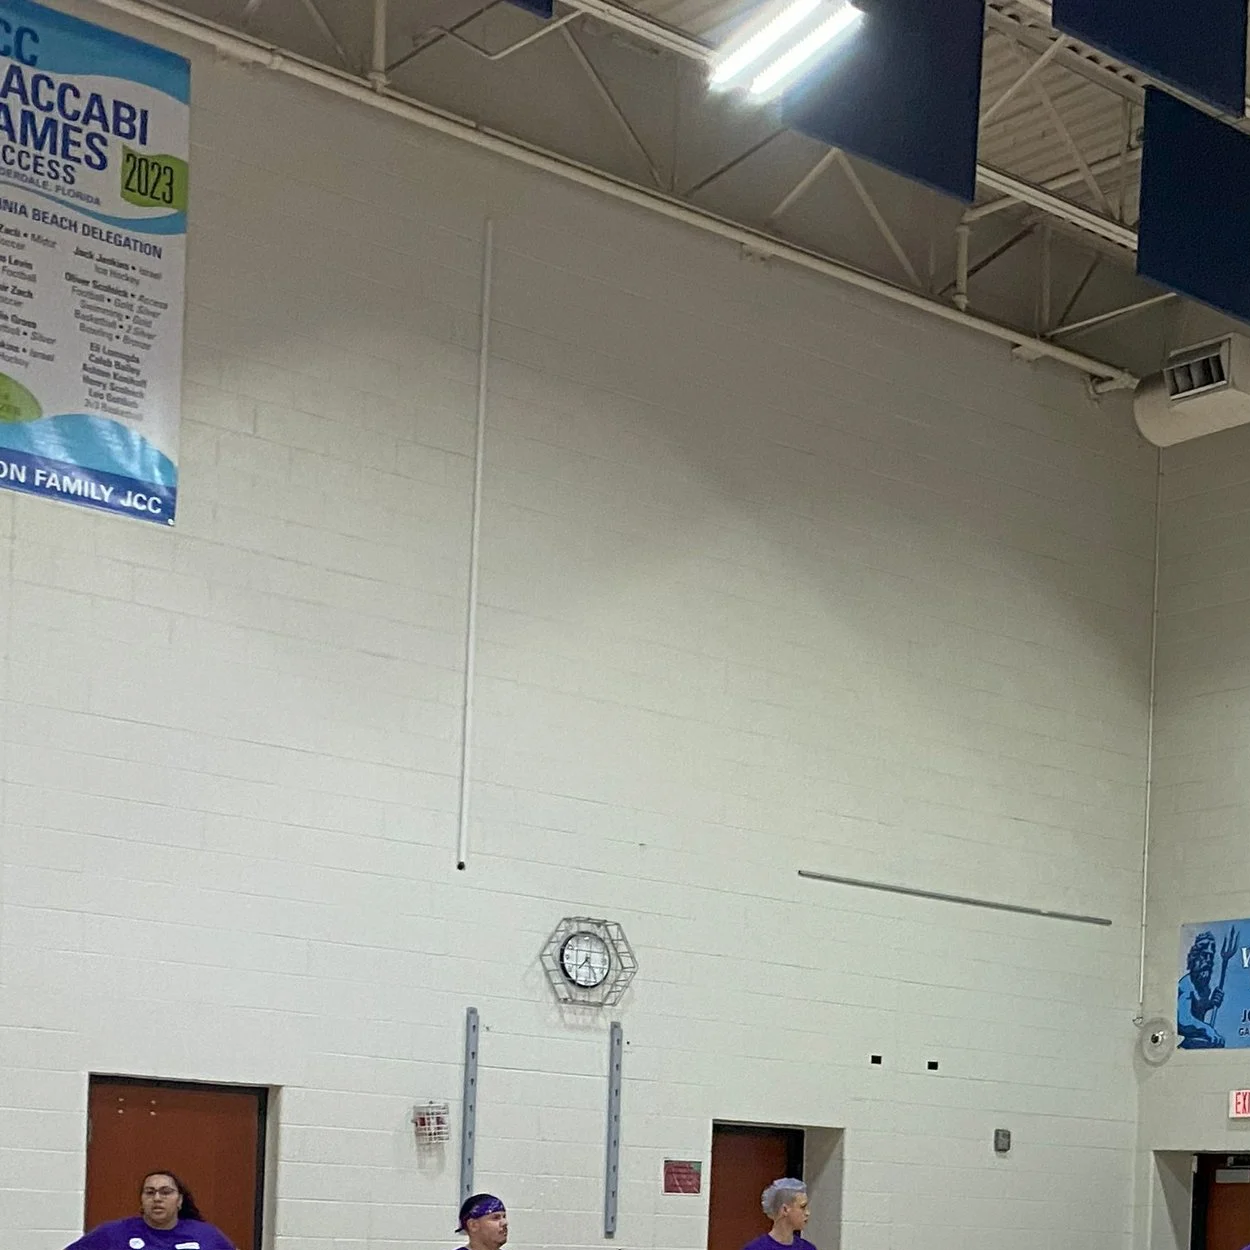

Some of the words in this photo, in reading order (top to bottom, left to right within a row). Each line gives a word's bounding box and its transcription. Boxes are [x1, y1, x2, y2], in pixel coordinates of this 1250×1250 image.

[2, 144, 76, 186] CCESS
[125, 153, 174, 205] 2023
[32, 207, 78, 234] BEACH
[81, 223, 162, 260] DELEGATION
[34, 468, 114, 503] FAMILY
[119, 490, 163, 514] JCC
